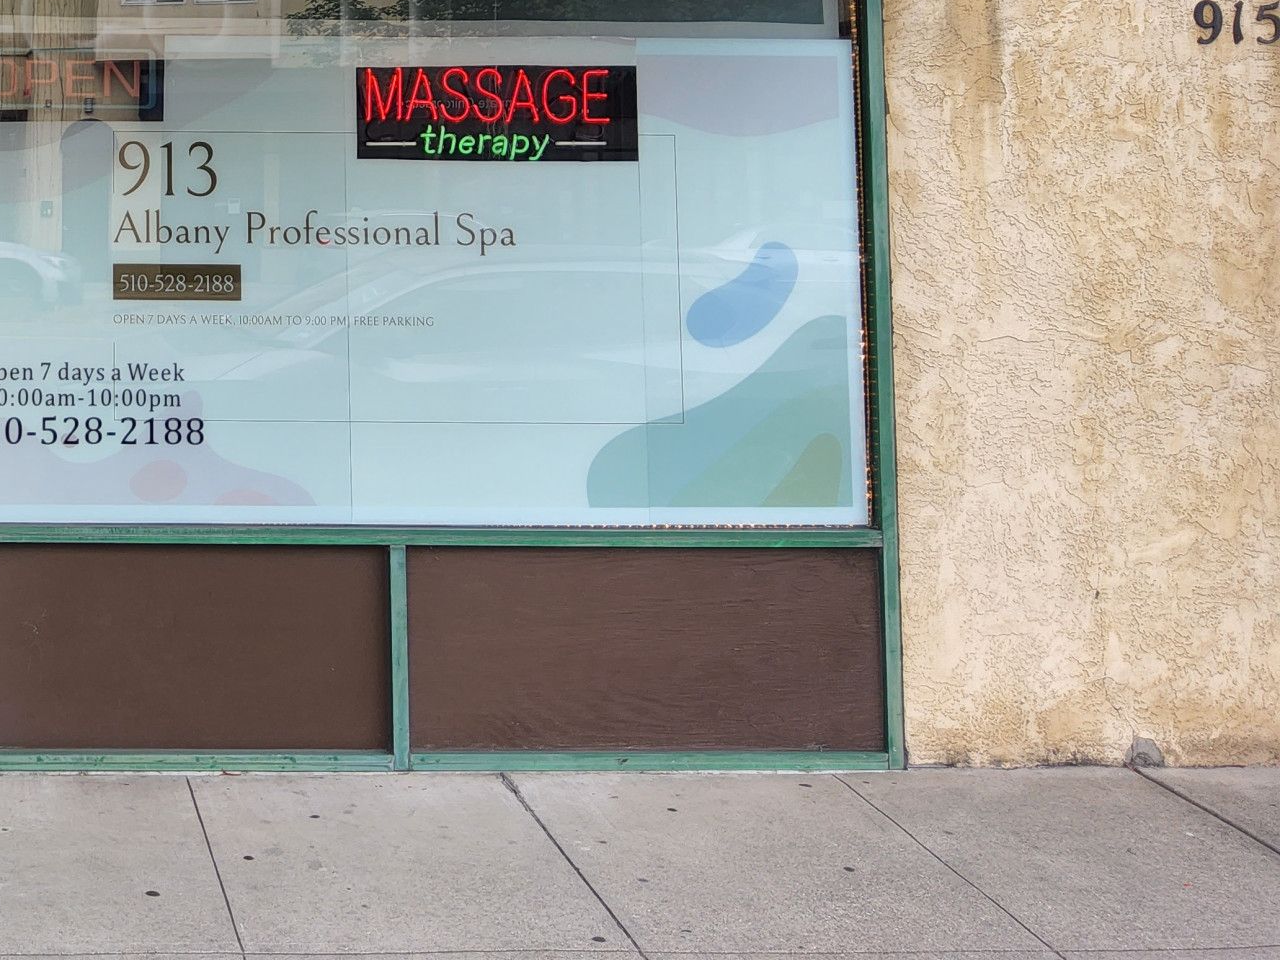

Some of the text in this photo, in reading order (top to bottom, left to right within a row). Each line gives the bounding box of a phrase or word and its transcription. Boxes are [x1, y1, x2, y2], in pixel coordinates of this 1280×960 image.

[1193, 0, 1280, 45] 915
[365, 67, 611, 123] MASSAGE
[420, 125, 550, 160] therapy
[119, 140, 218, 197] 913
[113, 209, 517, 256] Albany Professional Spa
[120, 274, 234, 293] 510-528-2188
[113, 314, 145, 325] OPEN
[147, 314, 154, 324] 7
[157, 314, 186, 325] DAYS
[189, 314, 198, 325] A
[201, 314, 235, 326] WEEK,
[285, 315, 302, 326] TO
[305, 315, 327, 326] 9:00
[353, 315, 379, 326] FREE
[382, 316, 434, 327] PARKING
[40, 362, 51, 381] 7
[58, 362, 105, 385] days
[111, 367, 121, 381] a
[128, 362, 185, 381] Week
